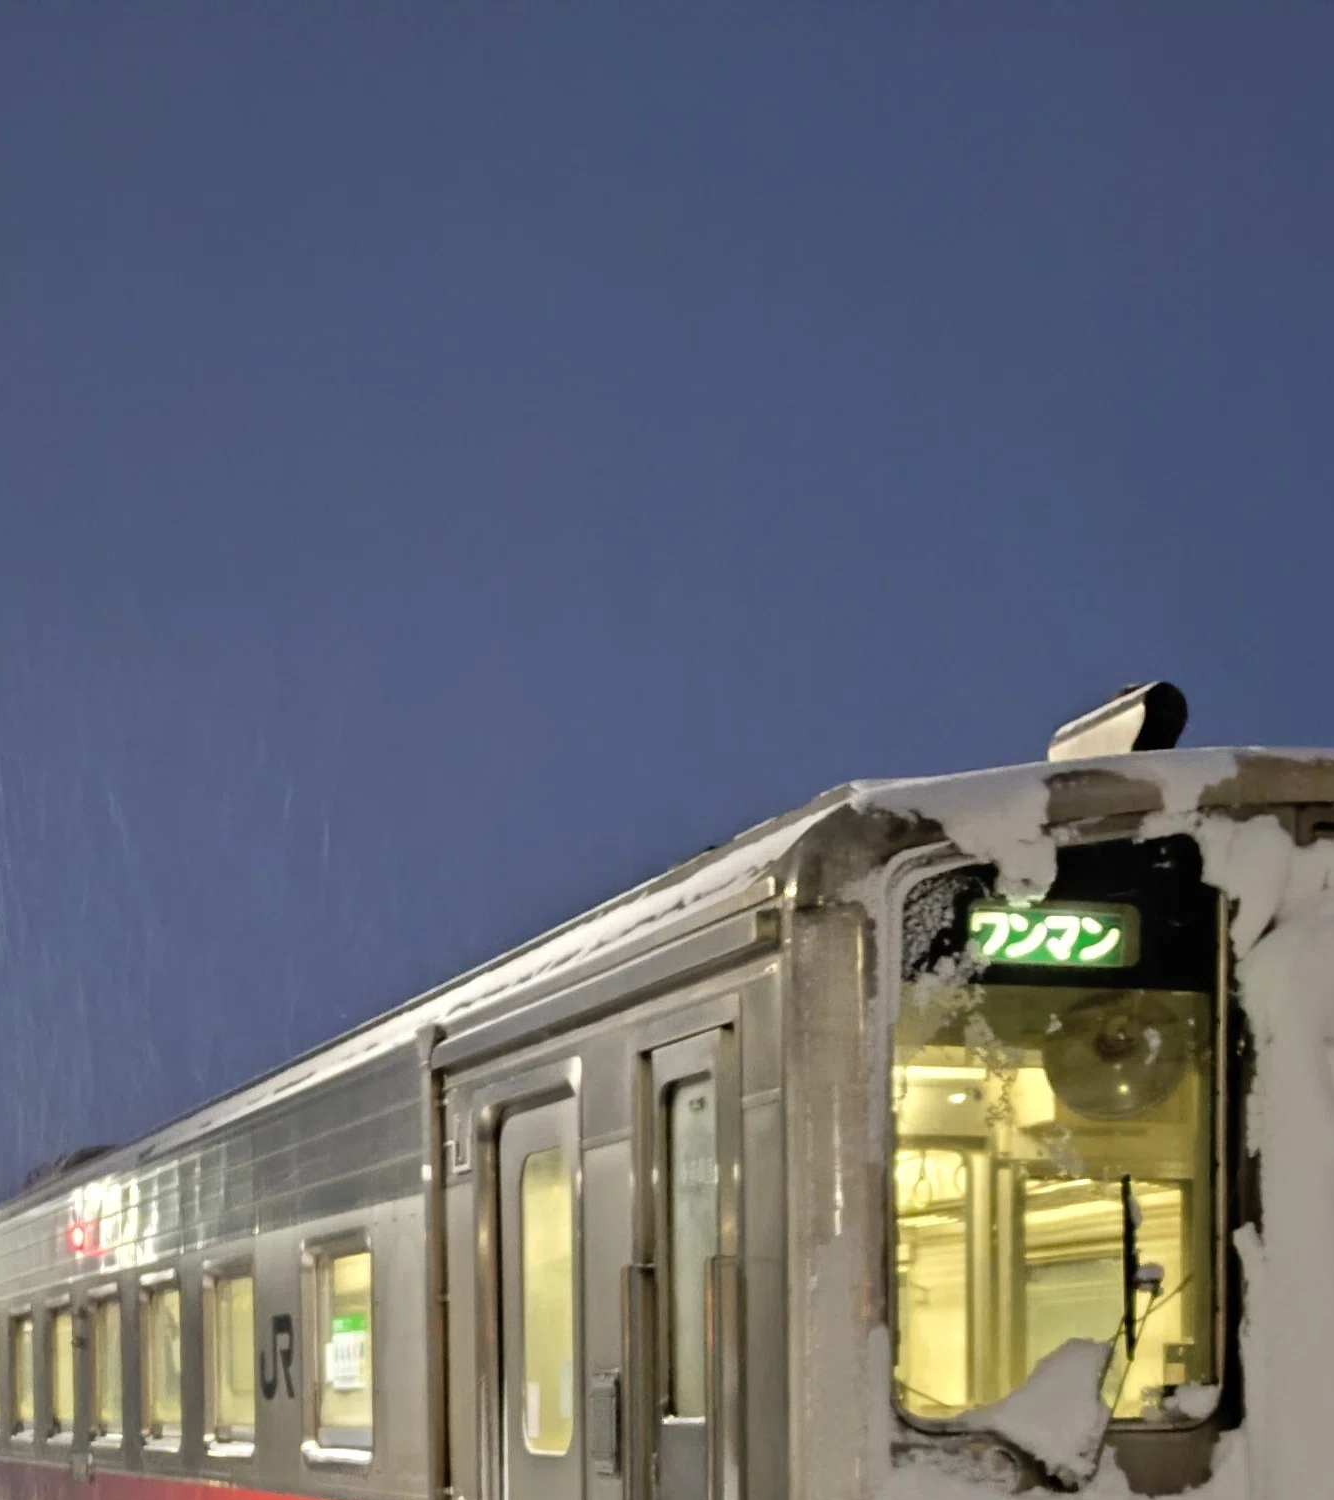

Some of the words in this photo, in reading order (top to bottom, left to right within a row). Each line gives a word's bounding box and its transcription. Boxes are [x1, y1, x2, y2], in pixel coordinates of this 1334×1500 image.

[970, 911, 1121, 960] ワンマン
[260, 1313, 295, 1400] JR
